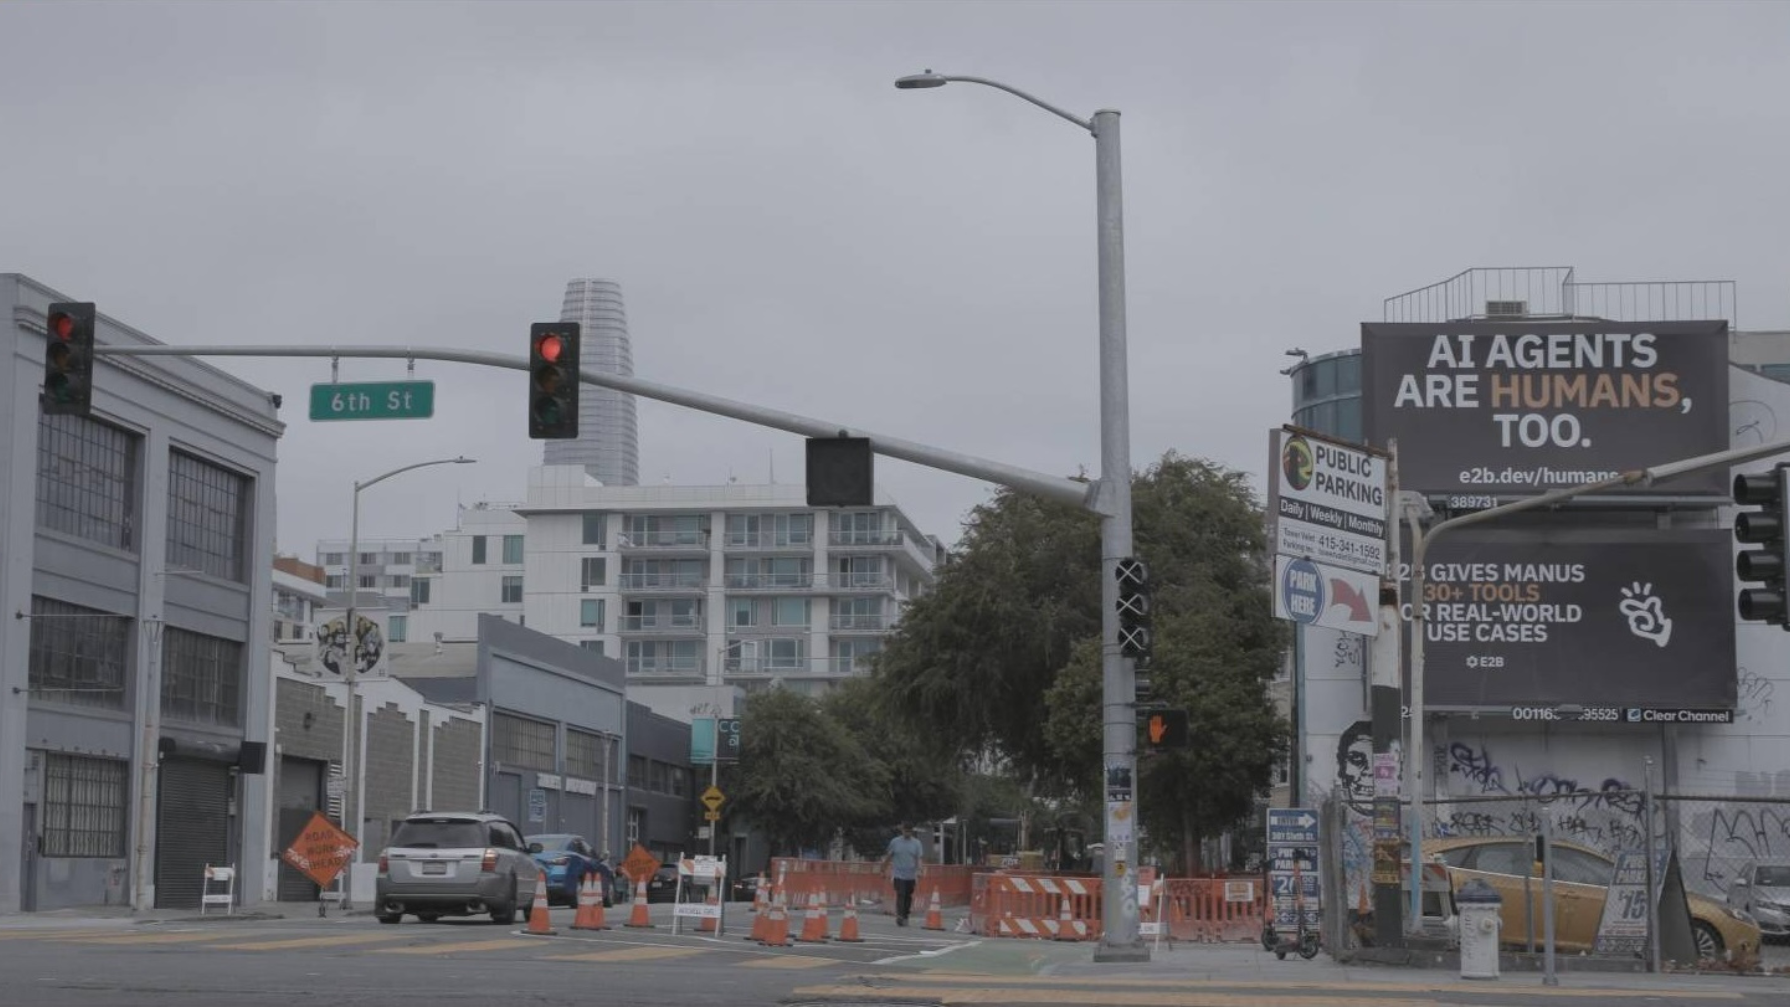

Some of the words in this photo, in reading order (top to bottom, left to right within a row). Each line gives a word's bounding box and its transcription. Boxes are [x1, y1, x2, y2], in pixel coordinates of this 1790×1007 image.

[1427, 334, 1475, 368] AI
[1485, 333, 1658, 369] AGENTS
[331, 393, 370, 412] 6th
[387, 391, 413, 410] St
[1394, 374, 1479, 408] ARE
[1490, 372, 1693, 413] HUMANS,
[1493, 413, 1592, 448] TOO.
[1315, 445, 1372, 478] PUBLIC
[1315, 472, 1382, 506] PARKING
[1450, 496, 1498, 508] 389731
[1280, 499, 1304, 518] Daily
[1309, 505, 1343, 527] Weekly
[1347, 515, 1383, 537] Monthly
[1289, 569, 1317, 592] PARK
[1430, 563, 1499, 582] GIVES
[1504, 564, 1585, 582] MANUS
[1424, 584, 1464, 602] 30+
[1469, 584, 1540, 602] TOOLS
[1437, 603, 1582, 622] REAL-WORLD
[1427, 623, 1470, 642] USE
[1475, 623, 1548, 642] CASES
[1480, 656, 1504, 668] E2B
[1643, 709, 1676, 721] Clear
[1677, 709, 1730, 722] Channel
[304, 829, 334, 842] ROAD
